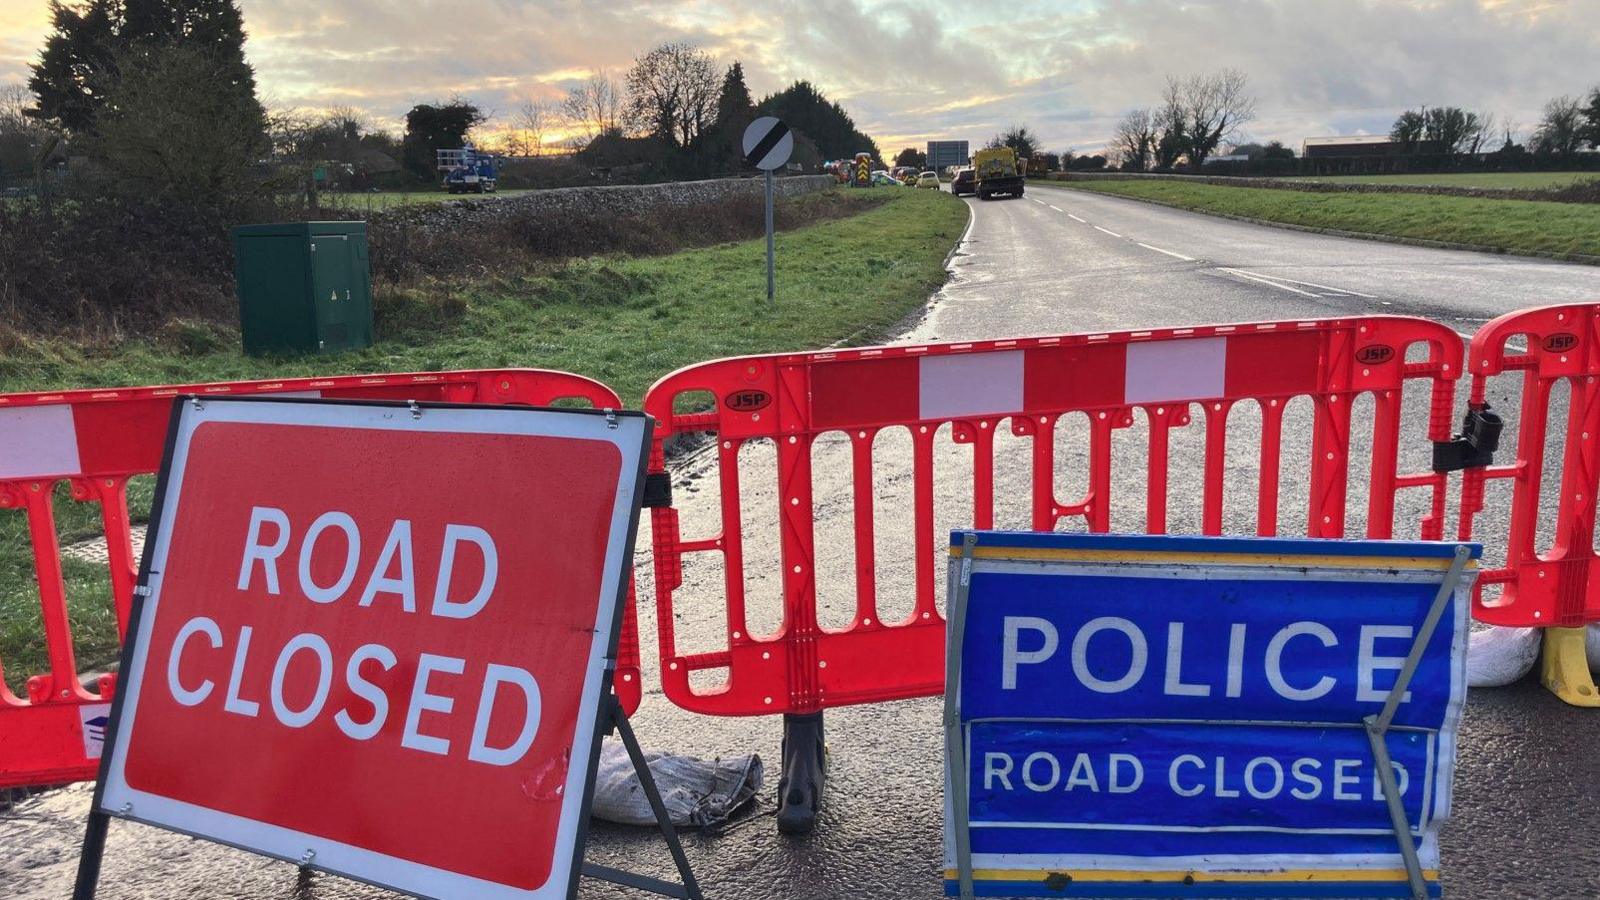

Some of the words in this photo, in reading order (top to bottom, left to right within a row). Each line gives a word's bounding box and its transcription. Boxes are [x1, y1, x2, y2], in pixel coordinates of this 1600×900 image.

[1363, 347, 1391, 361] JSP
[1548, 335, 1575, 350] JSP
[732, 392, 766, 408] JSP
[237, 506, 498, 618] ROAD
[1001, 615, 1413, 703] POLICE
[167, 616, 542, 767] CLOSED
[983, 751, 1145, 794] ROAD
[1168, 754, 1409, 801] CLOSED
